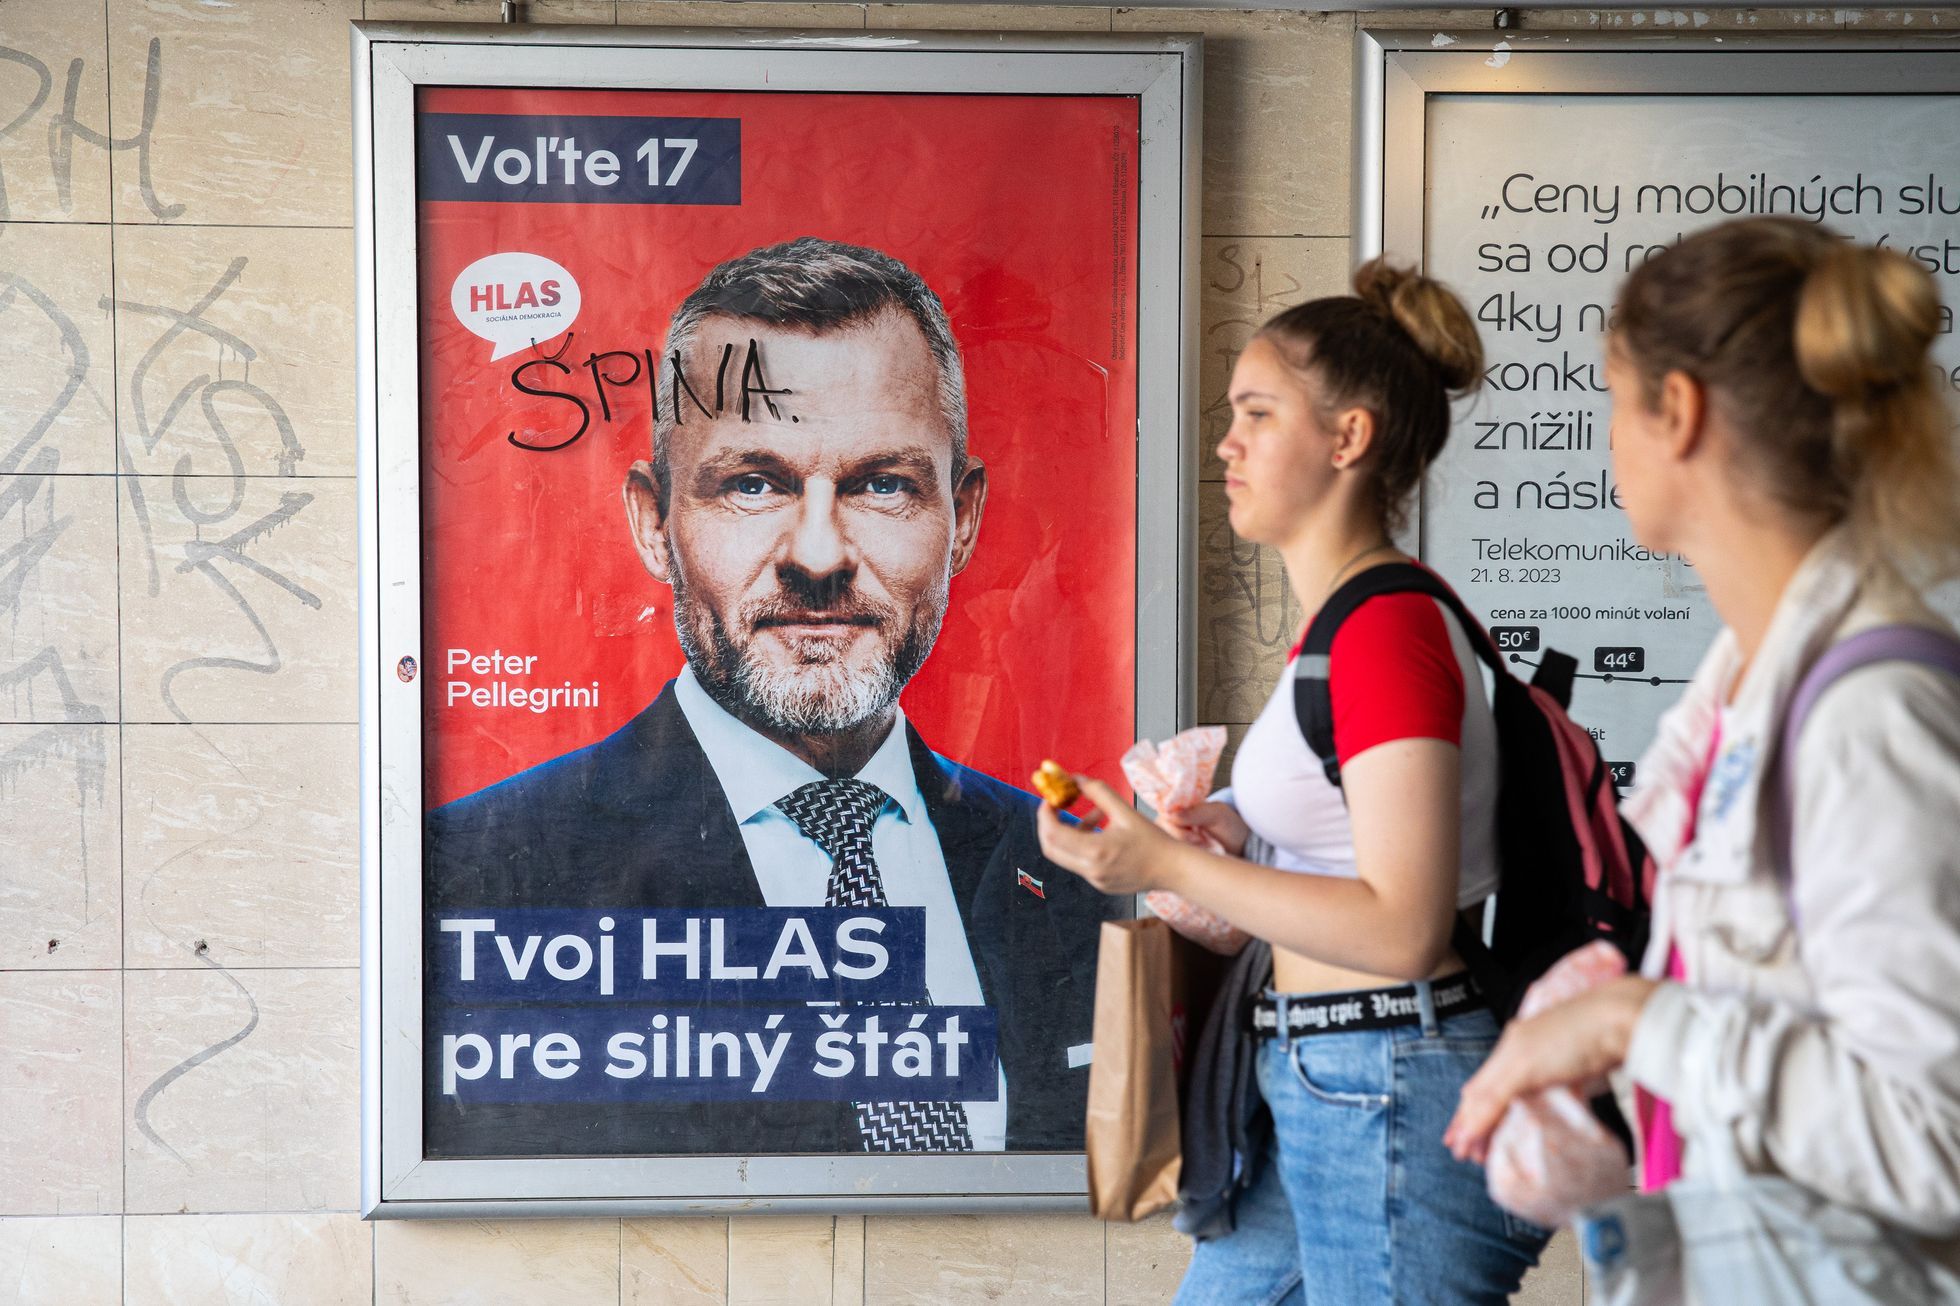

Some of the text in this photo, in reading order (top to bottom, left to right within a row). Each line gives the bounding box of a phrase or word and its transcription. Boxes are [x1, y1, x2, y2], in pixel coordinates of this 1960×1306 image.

[447, 134, 698, 186] Voľte 17
[1636, 172, 1883, 227] mobilných
[1478, 243, 1531, 273] sa
[1547, 231, 1609, 274] od
[470, 279, 562, 313] HLAS
[1477, 290, 1562, 343] 4ky
[1473, 409, 1593, 451] znížili
[1473, 480, 1499, 510] a
[1470, 567, 1561, 584] 21. 8. 2023
[1490, 606, 1691, 620] cena za 1000 minút volaní
[447, 648, 538, 675] Peter
[447, 681, 599, 714] Pellegrini
[440, 916, 889, 996] Tvoj HLAS
[442, 1012, 969, 1095] pre silný štát
